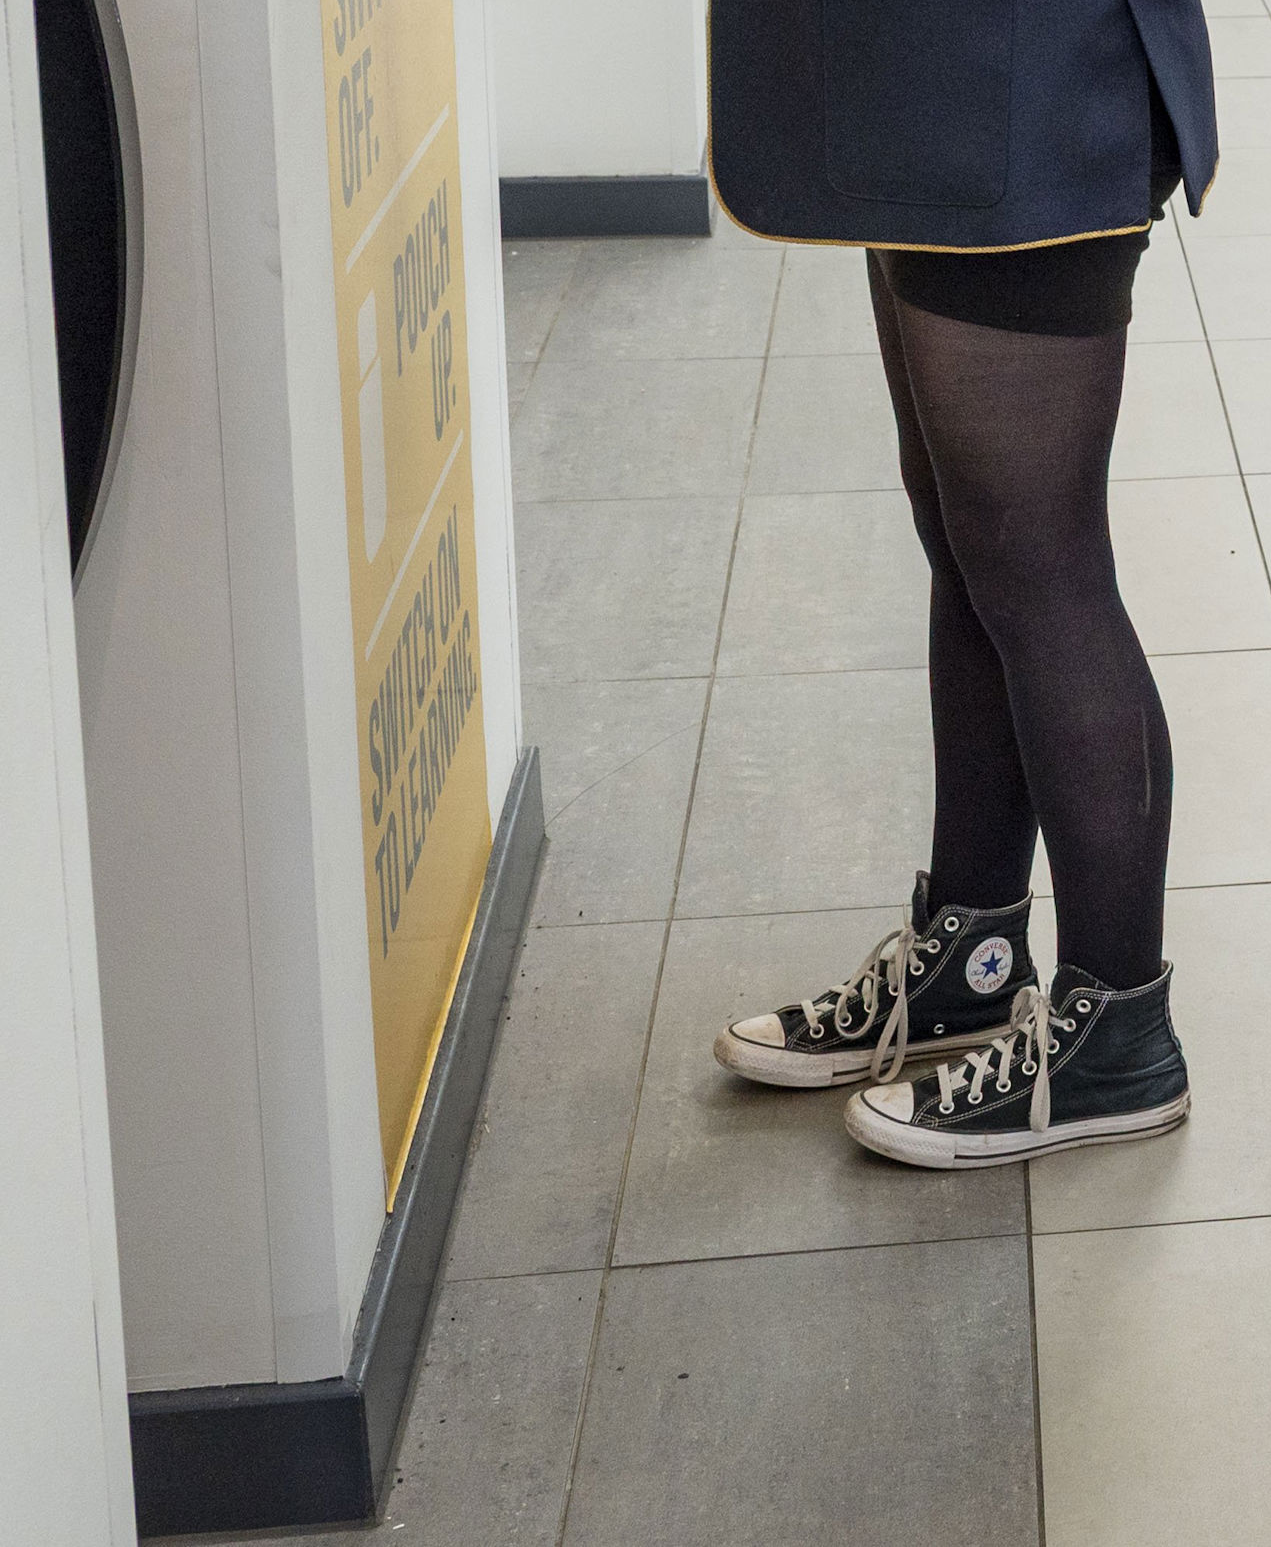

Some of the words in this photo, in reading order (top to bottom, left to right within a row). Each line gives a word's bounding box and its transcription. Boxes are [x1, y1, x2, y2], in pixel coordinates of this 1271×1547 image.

[338, 46, 379, 208] OFF.
[393, 178, 450, 377] POUCH
[431, 310, 456, 441] UP.
[369, 561, 437, 827] SWITCH
[437, 503, 461, 646] ON
[375, 810, 400, 959] TO
[401, 609, 478, 895] LEARNING.
[974, 942, 1009, 963] CONVERSE
